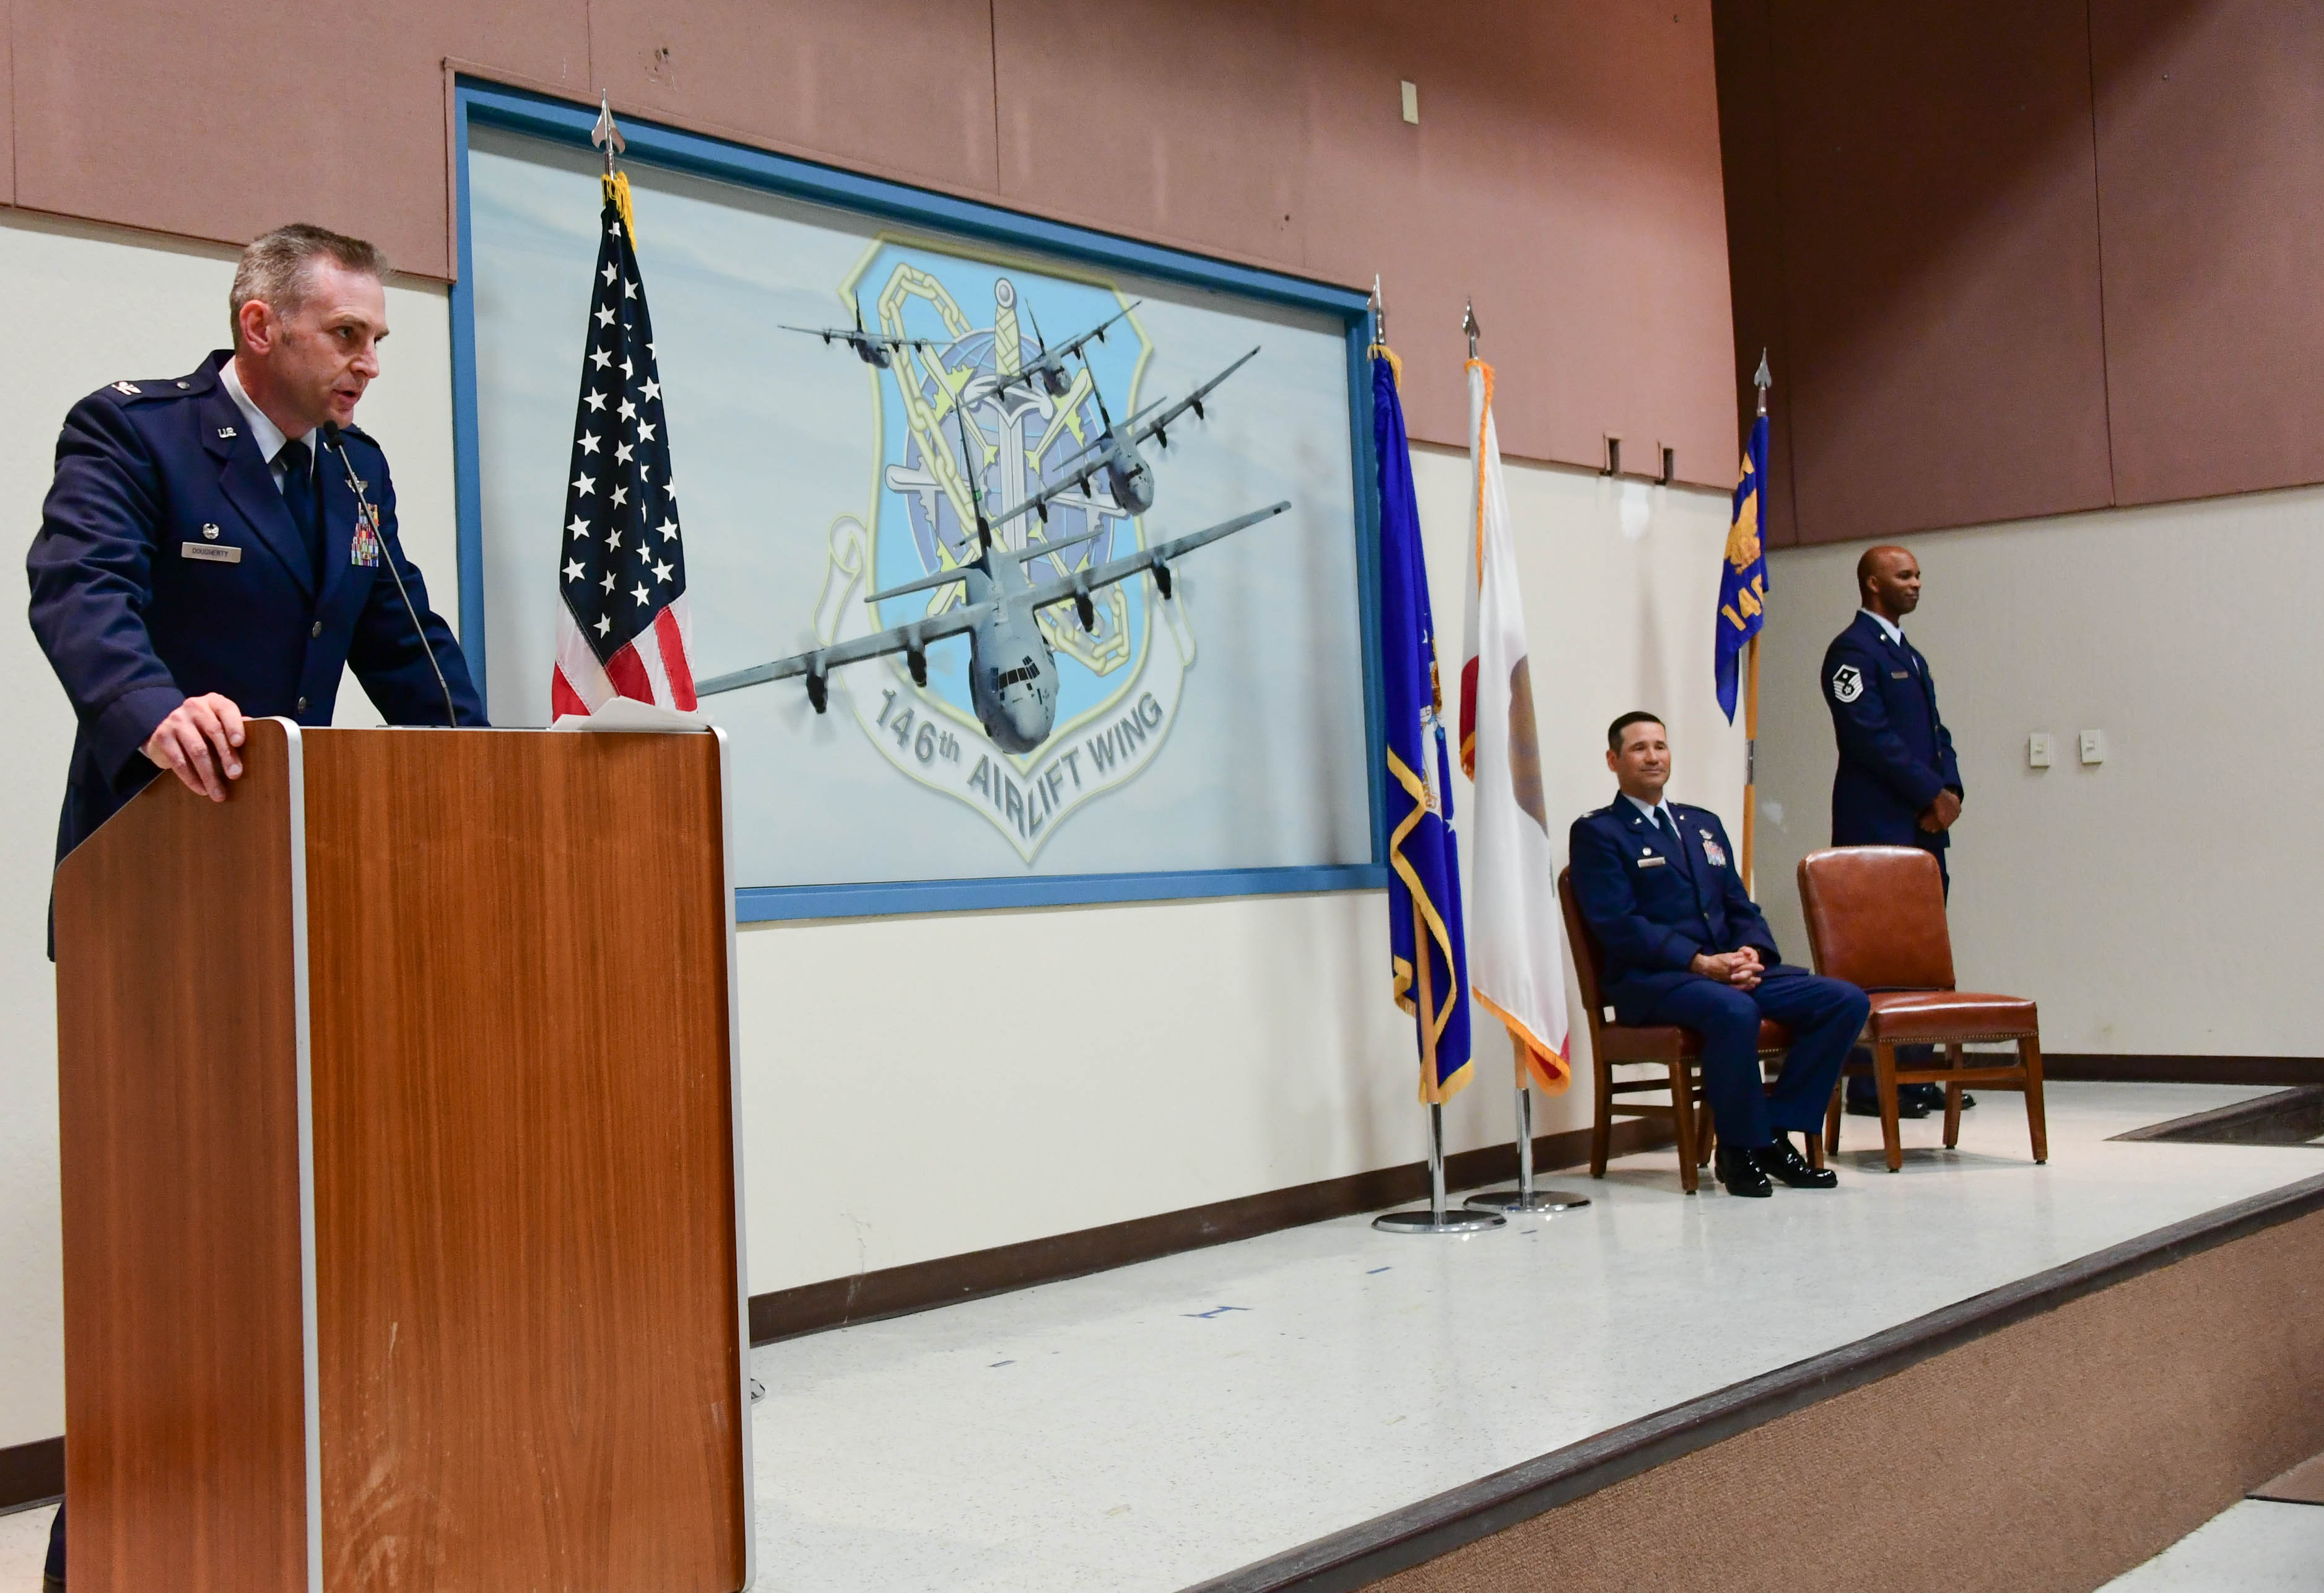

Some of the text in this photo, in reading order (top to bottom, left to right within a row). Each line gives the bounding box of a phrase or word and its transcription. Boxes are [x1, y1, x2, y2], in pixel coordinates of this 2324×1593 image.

[192, 548, 228, 557] DOUGHERTY
[876, 688, 1163, 838] 146th AIRLIFT WING
